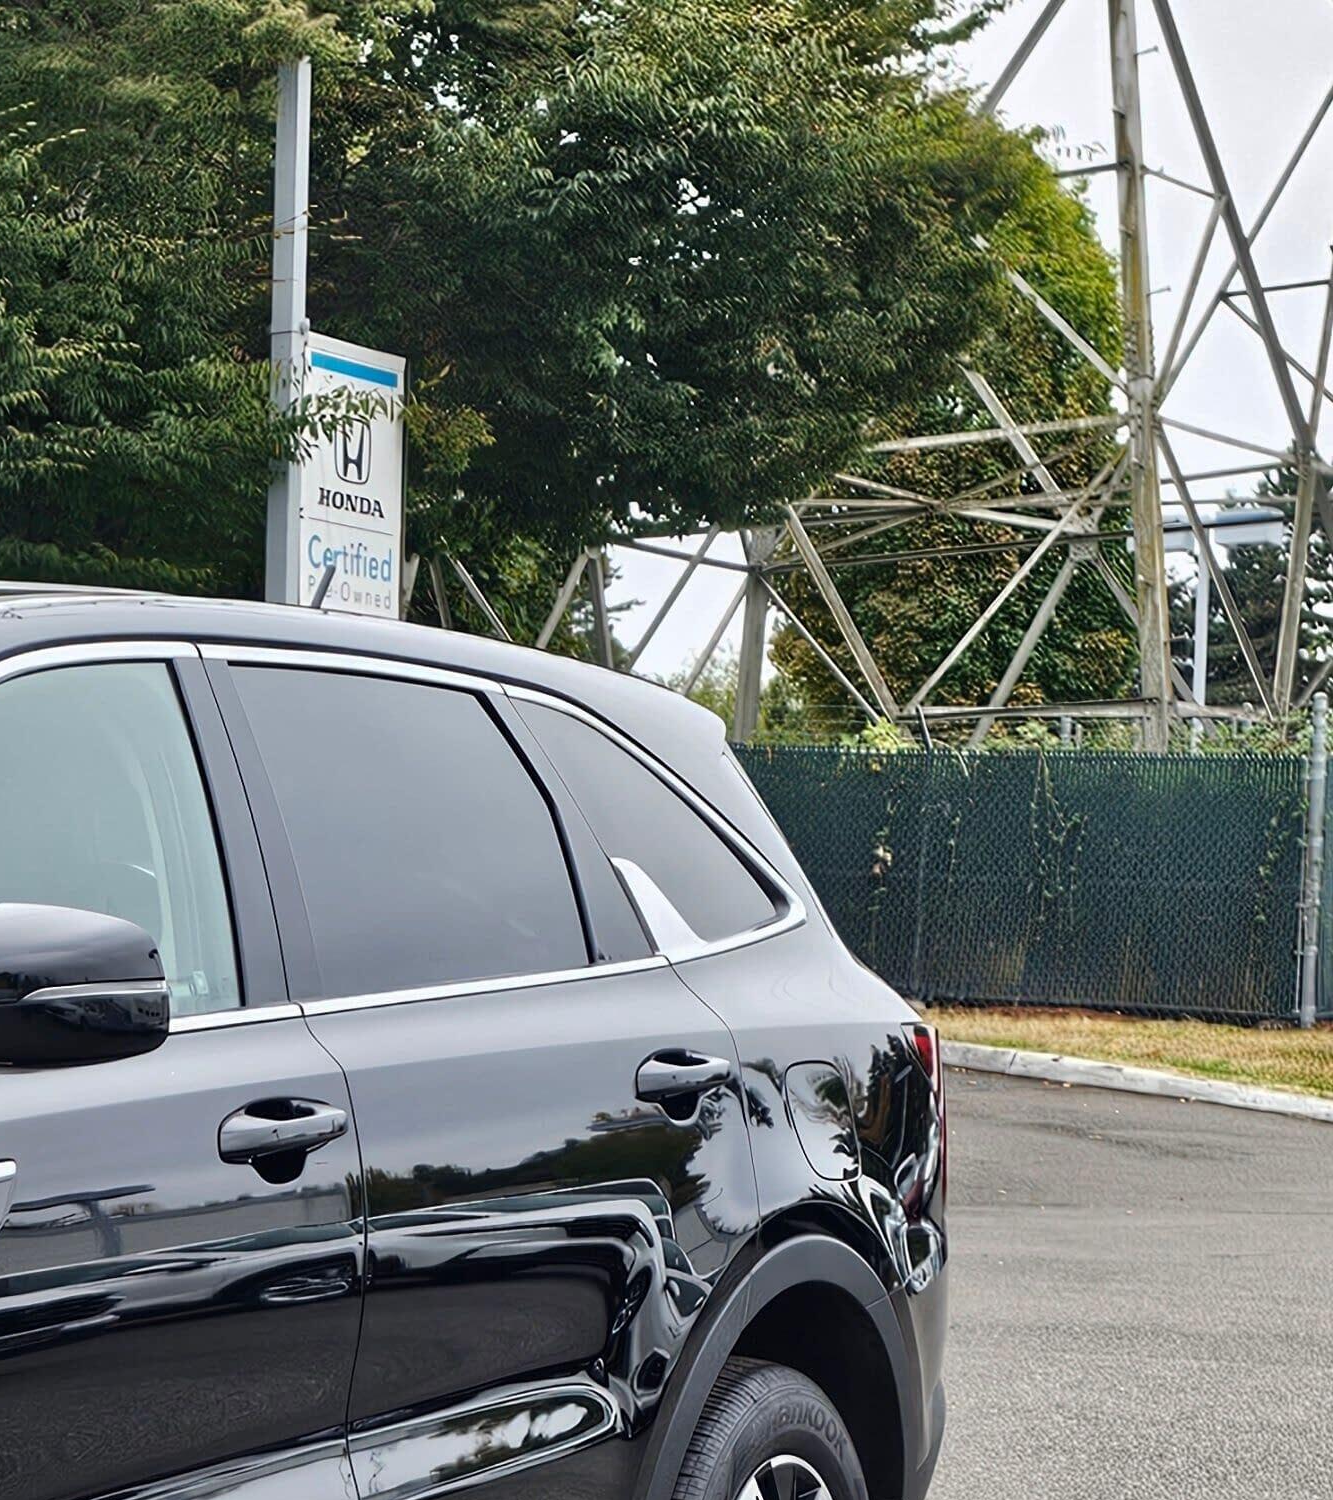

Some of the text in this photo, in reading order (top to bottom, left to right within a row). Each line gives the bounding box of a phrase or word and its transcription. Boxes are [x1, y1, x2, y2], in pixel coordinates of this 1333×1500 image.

[317, 487, 385, 519] HONDA
[307, 534, 392, 582] Certified
[308, 574, 392, 610] Pe-Owned
